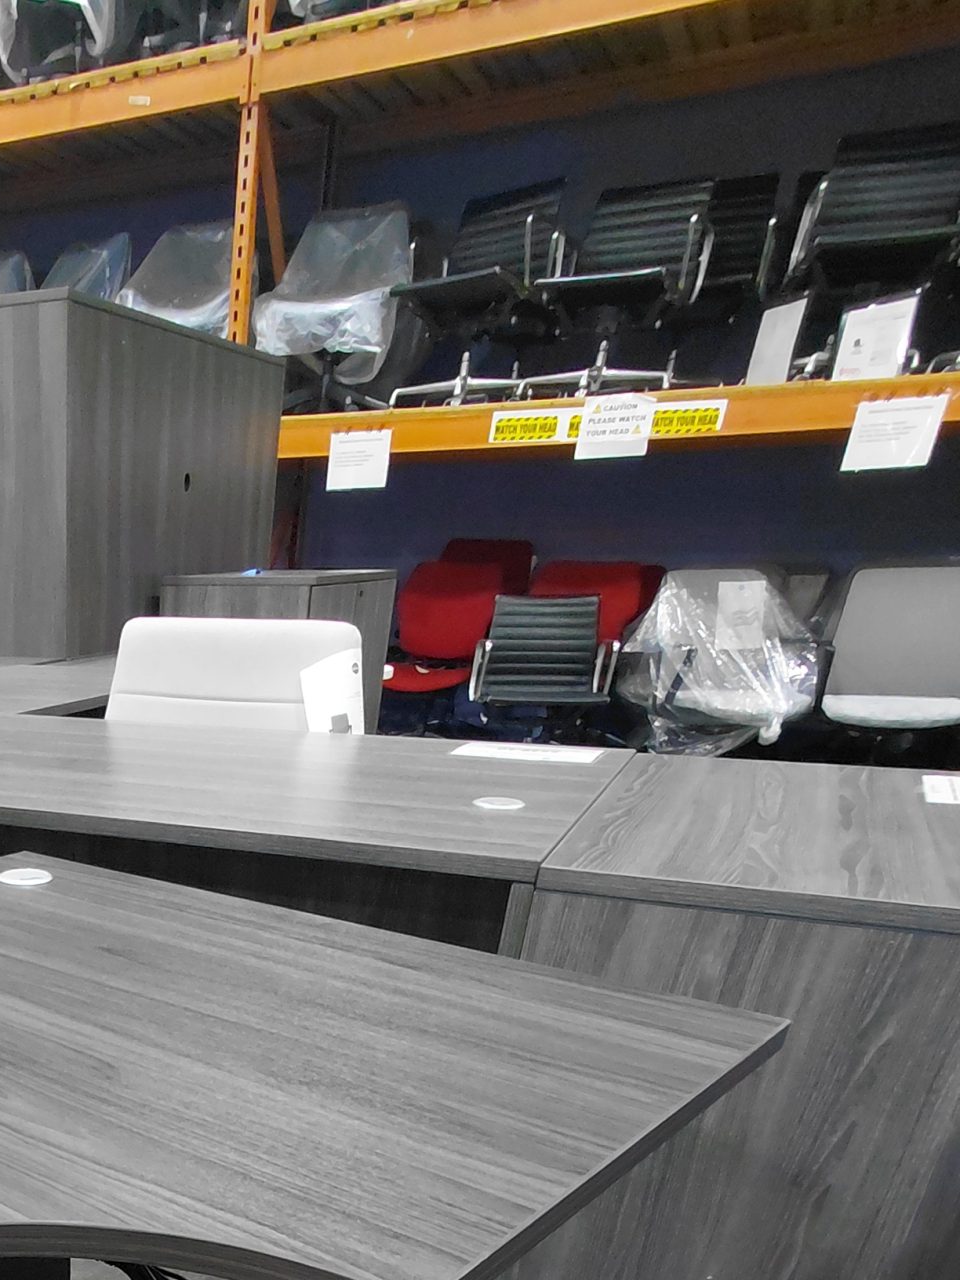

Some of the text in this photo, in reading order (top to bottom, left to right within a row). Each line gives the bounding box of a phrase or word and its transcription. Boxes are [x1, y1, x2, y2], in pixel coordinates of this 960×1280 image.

[603, 403, 638, 412] CAUTION
[588, 414, 647, 425] PLEASE WATCH
[653, 414, 719, 427] ATCH YOUR HEAD
[495, 423, 518, 434] WATCH
[519, 423, 538, 433] YOUR
[539, 421, 557, 433] HEAD
[586, 427, 630, 437] YOUR HEAD
